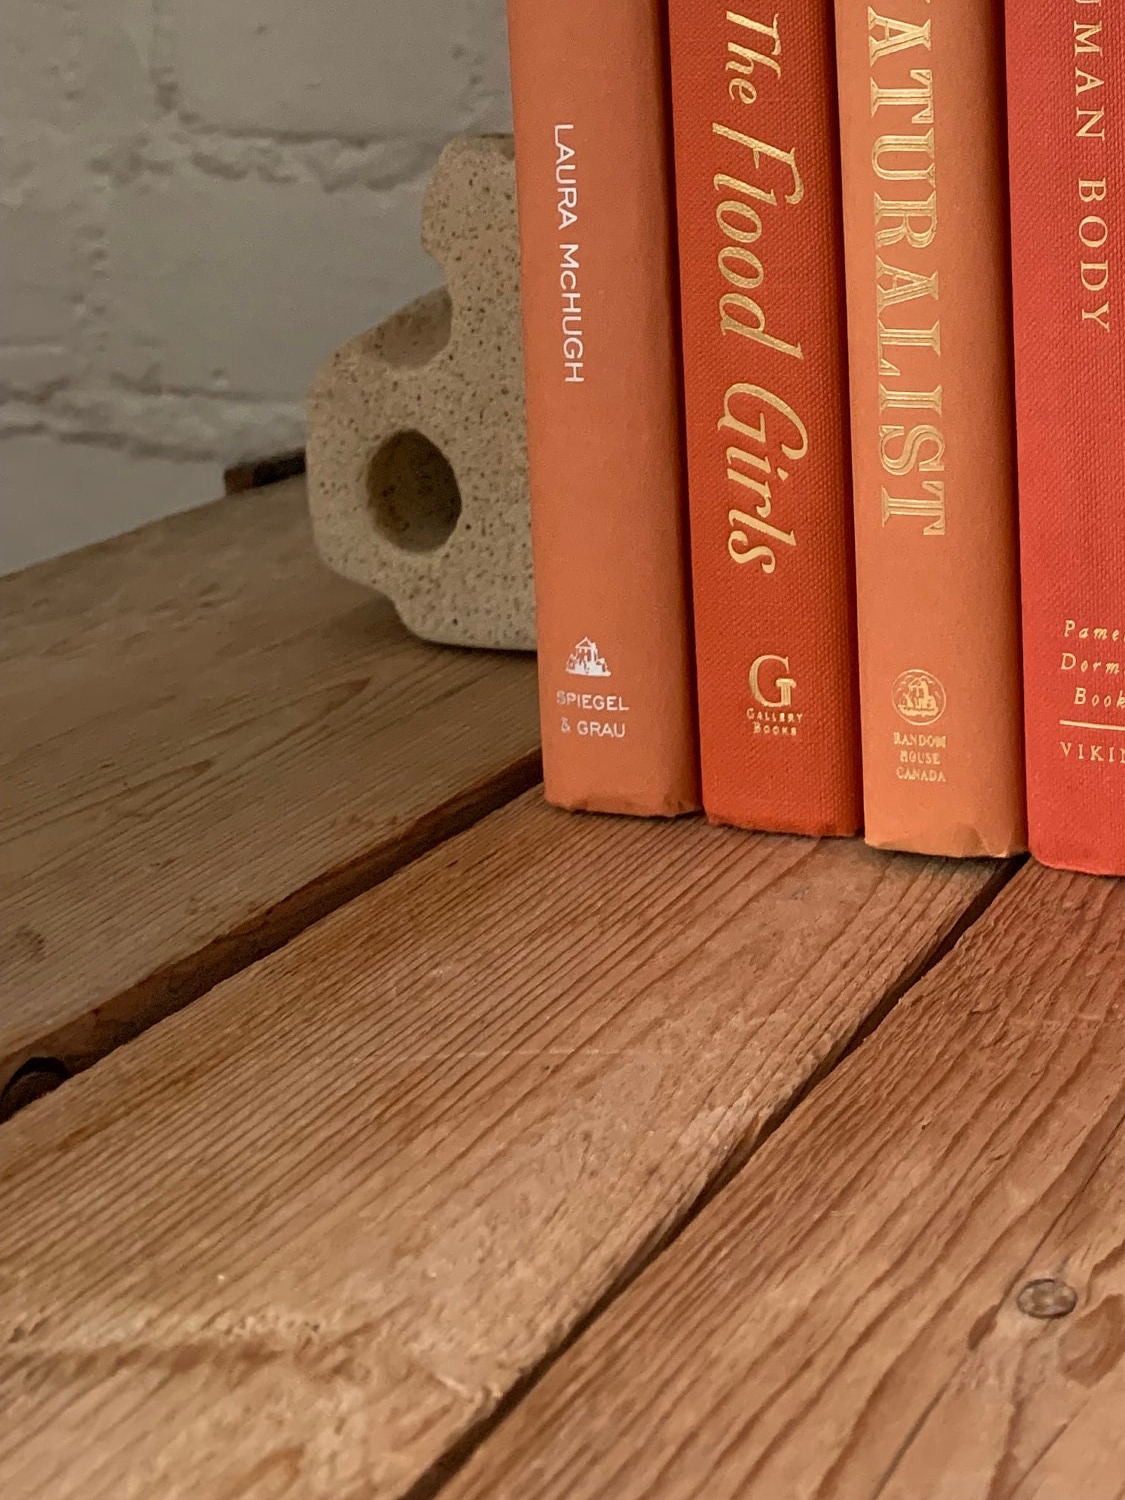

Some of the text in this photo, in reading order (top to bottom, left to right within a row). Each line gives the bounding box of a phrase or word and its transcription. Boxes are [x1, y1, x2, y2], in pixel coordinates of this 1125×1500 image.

[553, 124, 579, 231] LAURA
[1077, 176, 1111, 332] BODY
[712, 11, 809, 575] The Flood Girls
[556, 690, 629, 711] SPIEGEL
[560, 718, 626, 739] & GRAU
[900, 749, 940, 766] HOUSE
[896, 765, 946, 783] CANADA
